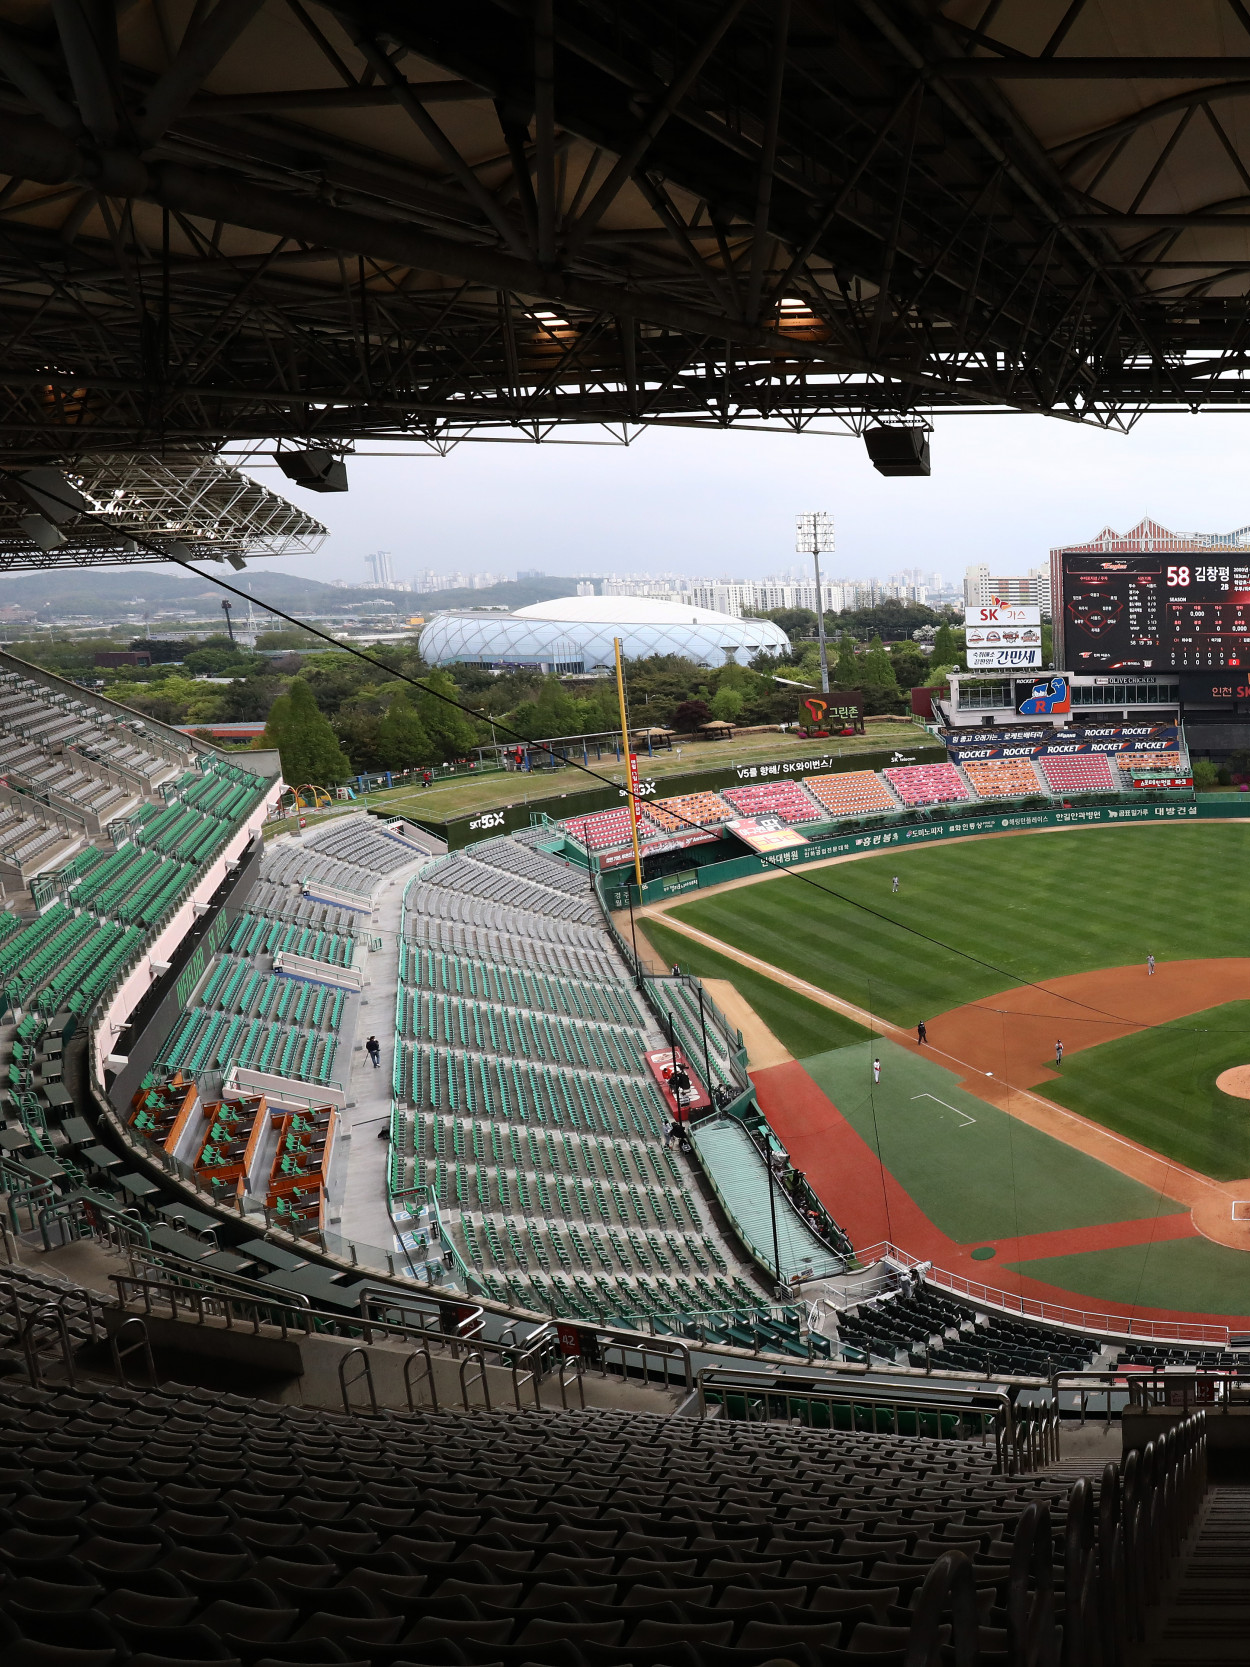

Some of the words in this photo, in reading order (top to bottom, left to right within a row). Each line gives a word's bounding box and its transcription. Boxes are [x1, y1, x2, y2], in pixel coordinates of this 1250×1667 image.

[1166, 566, 1190, 586] 58
[1195, 566, 1230, 582] 김창평
[980, 608, 998, 621] SK
[1007, 611, 1026, 620] 가스
[996, 650, 1036, 665] 간만세
[1212, 687, 1232, 697] 인천
[1035, 700, 1046, 712] R
[829, 707, 859, 718] 그린존
[958, 750, 992, 759] ROCKET
[1003, 747, 1036, 756] ROCKET
[1047, 745, 1080, 753] ROCKET
[1091, 743, 1123, 751] ROCKET
[737, 767, 757, 779] V5를
[760, 765, 780, 776] 향해!
[783, 759, 833, 773] SK와이번스!
[1056, 811, 1101, 821] 한길안과병원
[1118, 809, 1149, 817] 곰표밀가루
[1155, 807, 1198, 816] 대방건설
[470, 820, 481, 830] SKT
[481, 812, 505, 828] 5GX
[1009, 816, 1048, 826] 해링턴플레이스
[912, 826, 943, 838] 도미노피자
[761, 850, 799, 868] 인하대병원
[562, 1336, 576, 1346] 42
